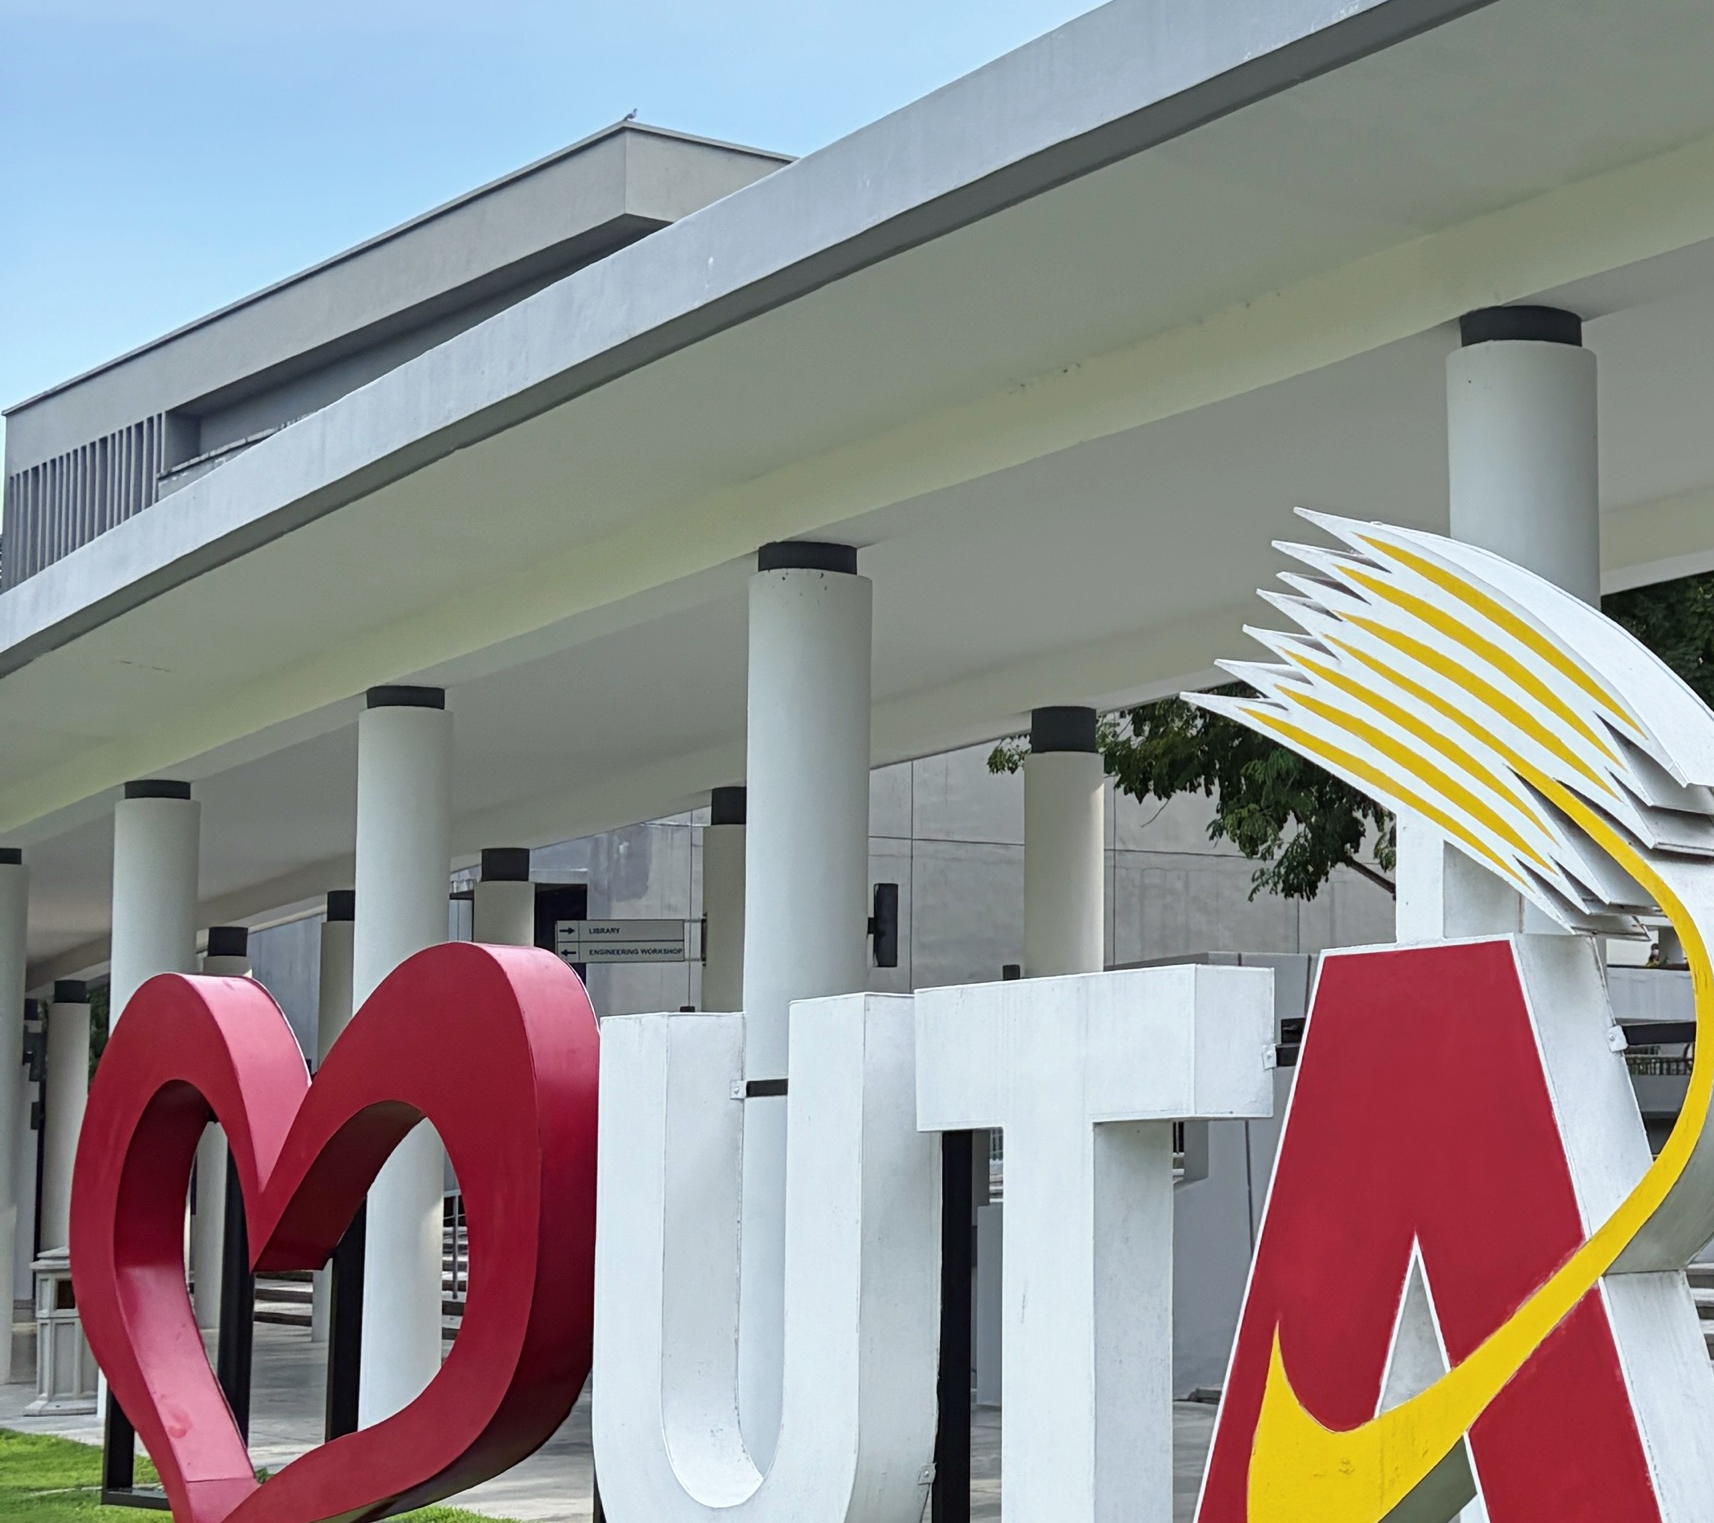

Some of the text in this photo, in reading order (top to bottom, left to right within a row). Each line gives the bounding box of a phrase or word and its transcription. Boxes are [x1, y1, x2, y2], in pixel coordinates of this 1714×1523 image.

[588, 927, 620, 935] LIBRARY
[589, 947, 683, 956] ENGINEERING WORKSHOP
